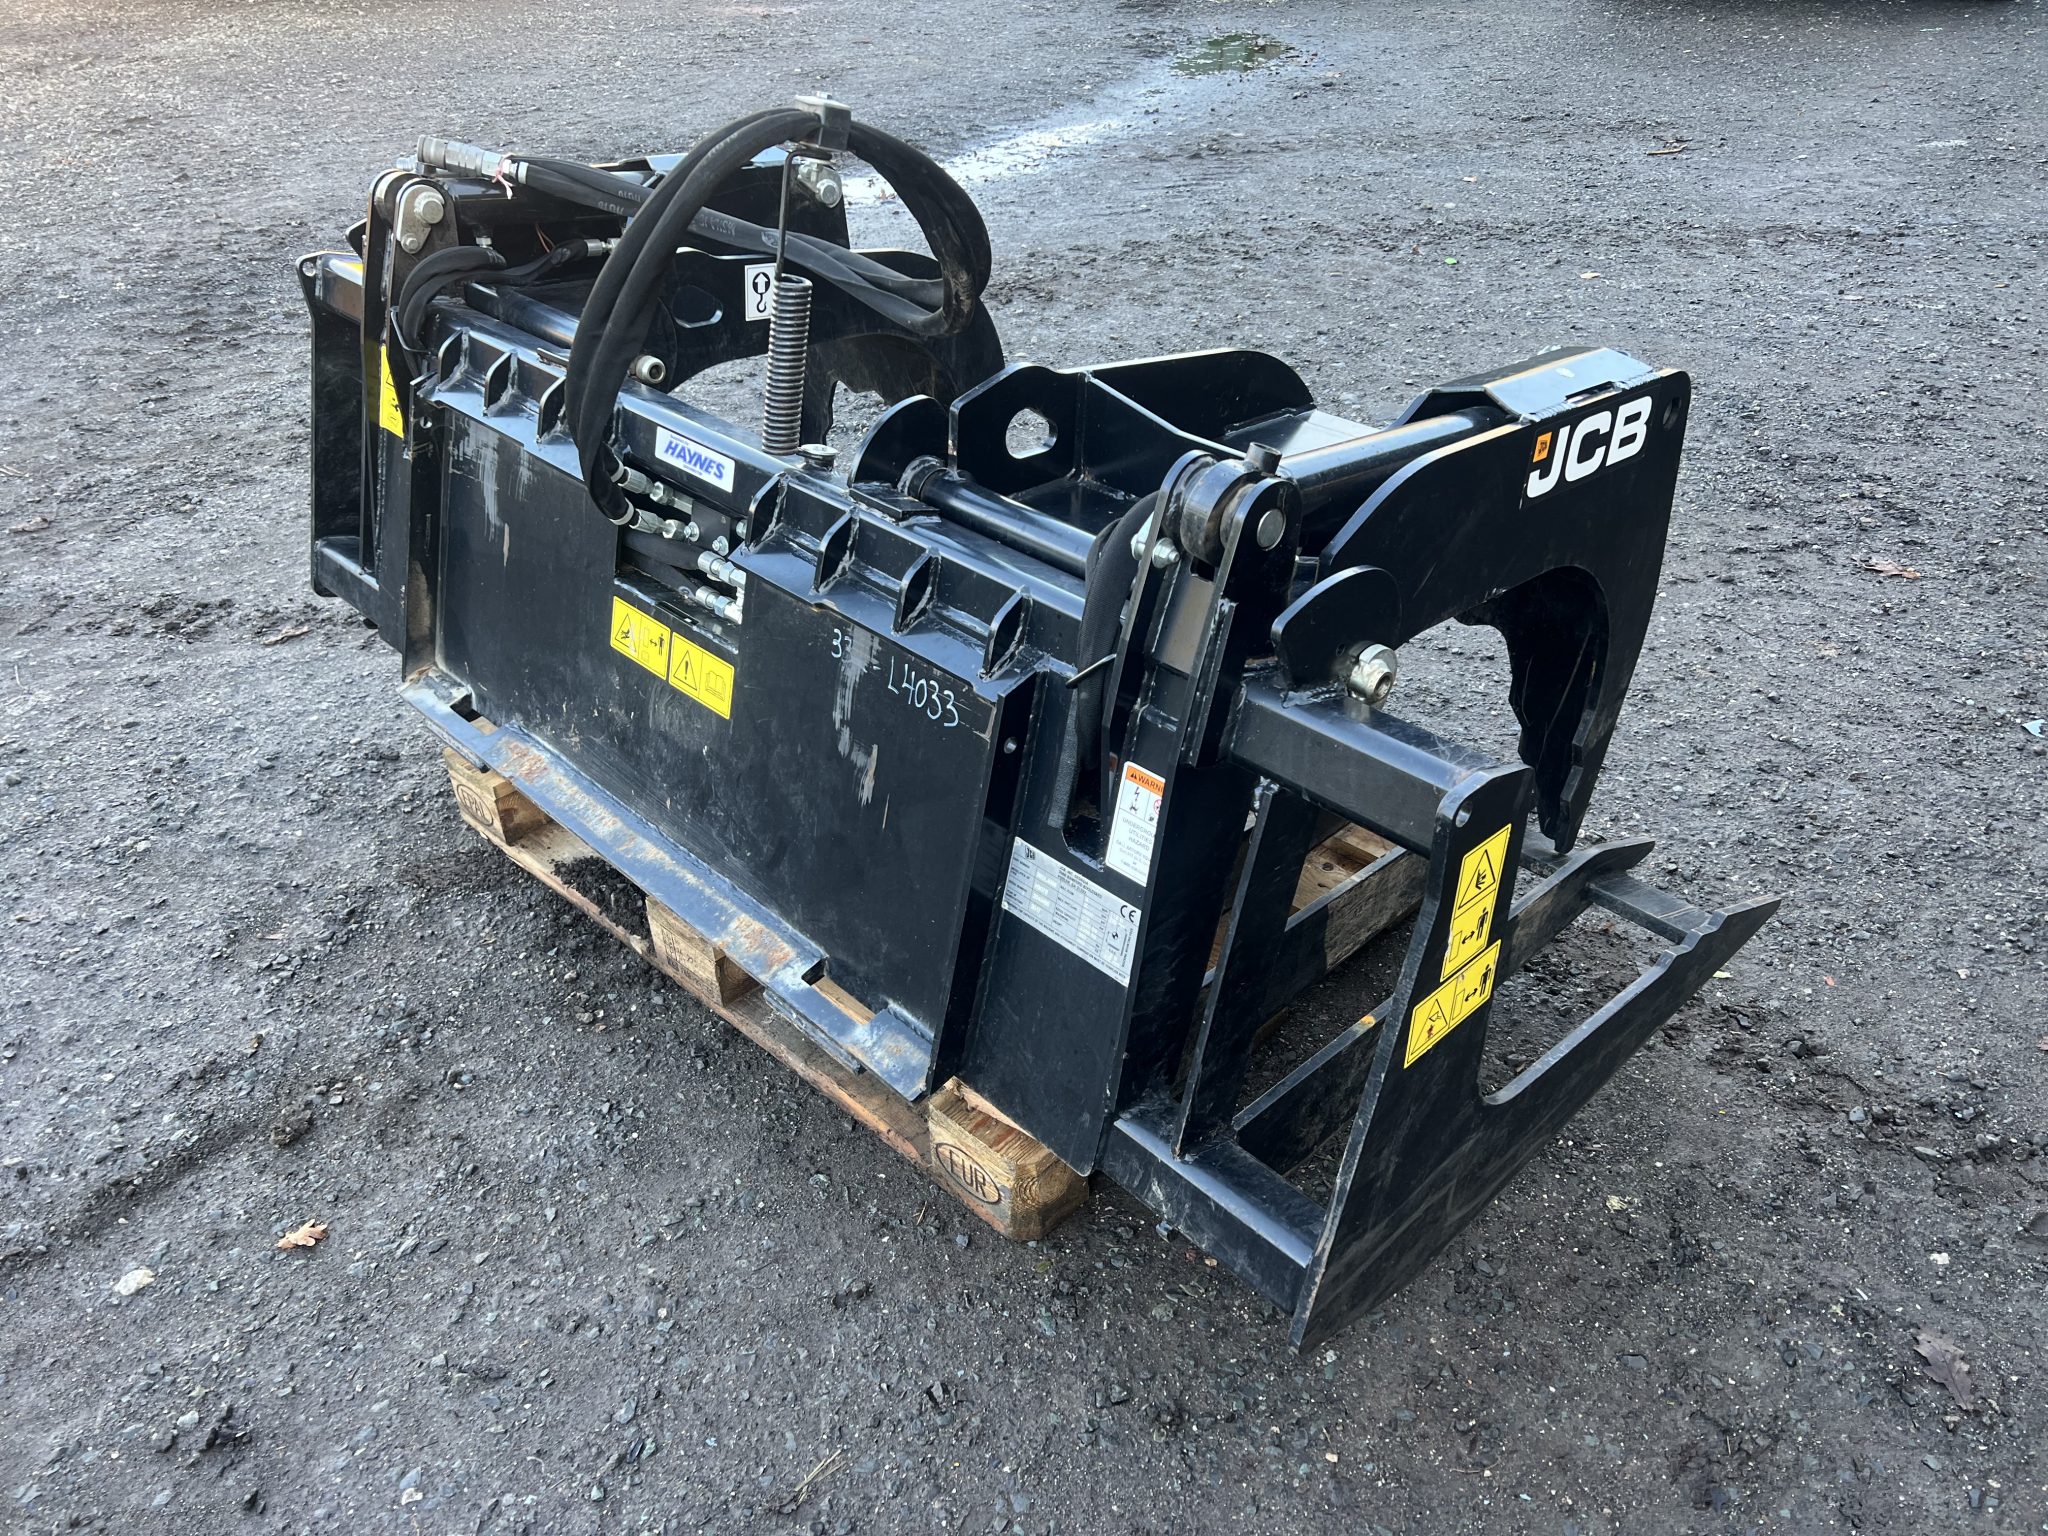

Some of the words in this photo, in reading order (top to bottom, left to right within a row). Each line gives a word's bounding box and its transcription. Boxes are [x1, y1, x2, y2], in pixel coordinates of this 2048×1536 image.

[664, 440, 725, 480] HAYNES
[1527, 396, 1652, 498] JCB
[888, 656, 959, 727] L4033
[949, 1149, 987, 1198] EUR
